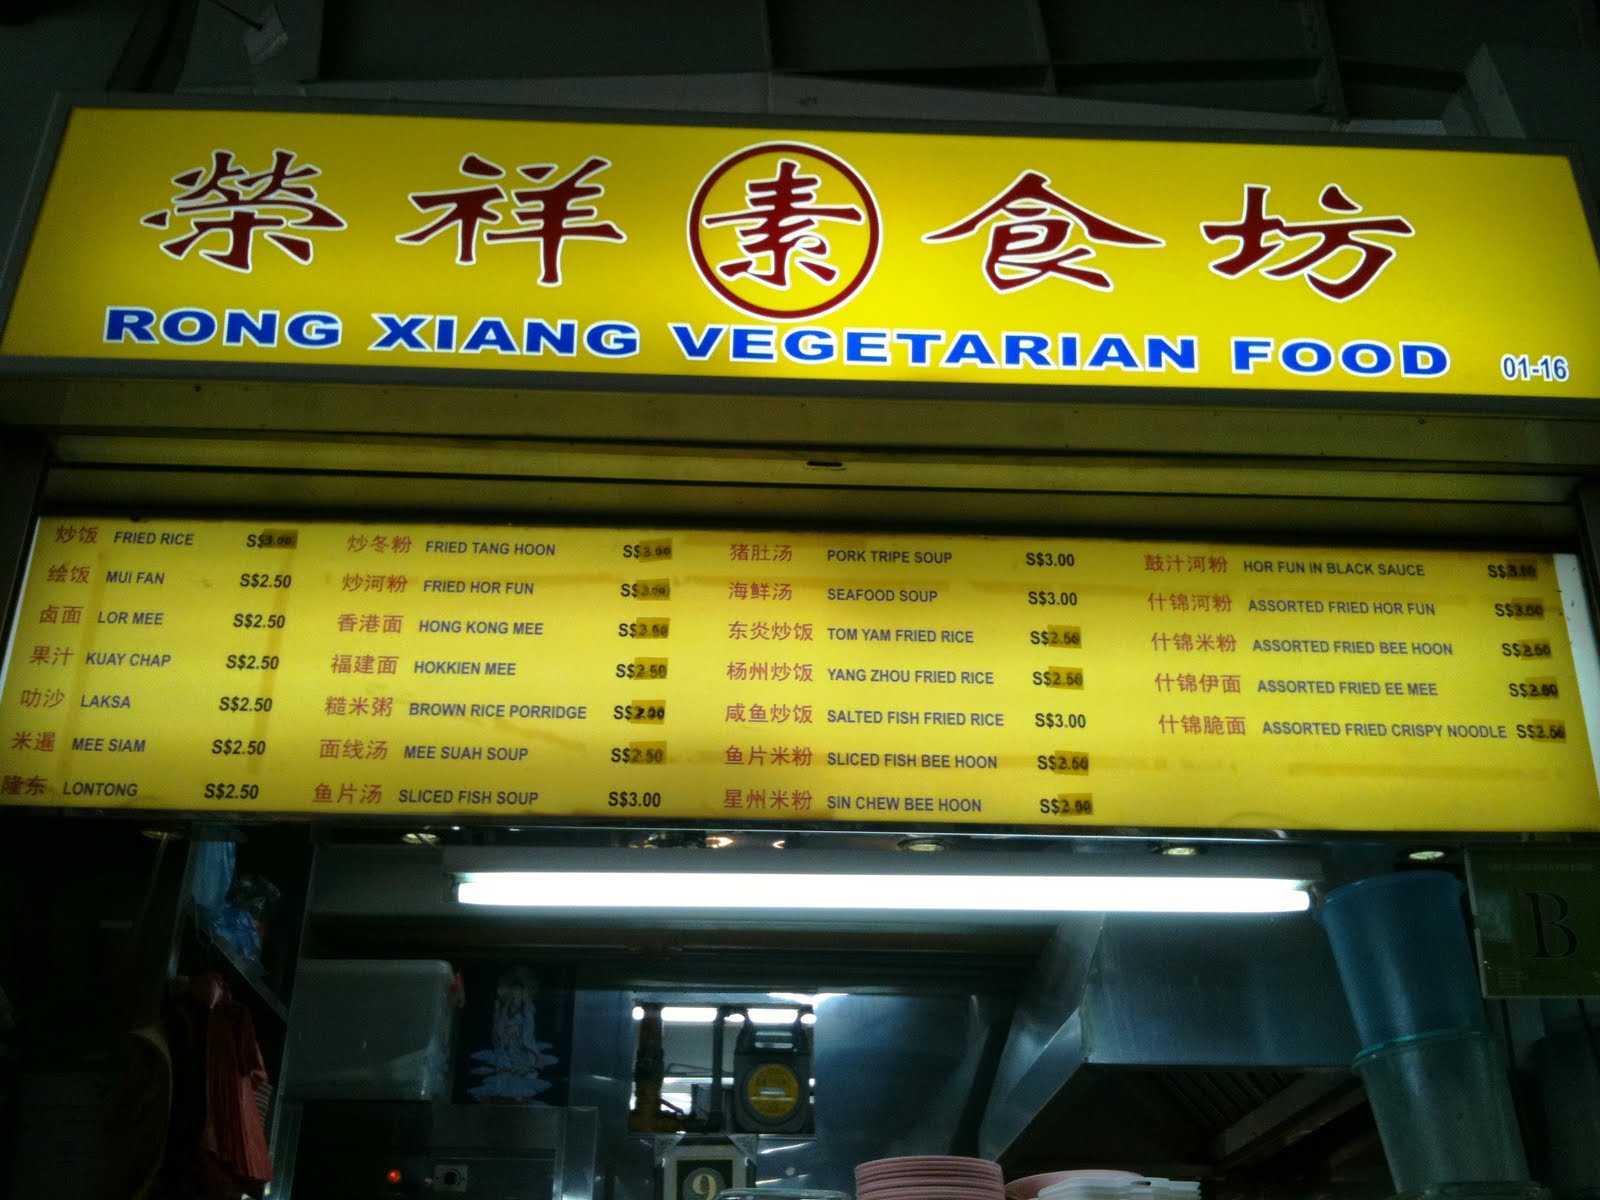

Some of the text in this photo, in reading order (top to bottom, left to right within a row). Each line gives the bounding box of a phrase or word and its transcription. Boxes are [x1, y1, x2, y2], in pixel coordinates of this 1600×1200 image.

[104, 305, 1452, 380] RONG XIANG VEGETARIAN FOOD
[1499, 353, 1570, 383] 01-16
[54, 526, 99, 545] 炒饭
[113, 530, 195, 546] FRIED RICE
[347, 534, 413, 555] 炒冬粉
[425, 540, 556, 556] FRIED TANG HOON
[730, 543, 793, 563] 猪肚汤
[827, 548, 953, 564] PORK TRIPE SOUP
[1025, 552, 1076, 568] S$3.00
[1243, 560, 1426, 576] HOR FUN IN BLACK SAUCE
[105, 570, 165, 585] MUI FAN
[240, 573, 293, 589] S$2.50
[341, 573, 408, 593] 炒河粉
[423, 579, 535, 595] FRIED HOR FUN
[728, 582, 793, 601] 海鲜汤
[827, 587, 939, 603] SEAFOOD SOUP
[1027, 591, 1078, 607] S$3.00
[1147, 592, 1232, 612] 什锦河粉
[1248, 599, 1436, 616] ASSORTED FRIED HOR FUN
[38, 605, 83, 626] 卤面
[96, 610, 164, 626] LOR MEE
[232, 613, 286, 630] S$2.50
[336, 613, 404, 635] 香港面
[418, 619, 544, 636] HONG KONG MEE
[727, 621, 814, 642] 东炎炒饭
[826, 627, 975, 644] TOM YAM FRIED RICE
[1151, 632, 1237, 653] 什锦米粉
[1252, 639, 1454, 656] ASSORTED FRIED BEE HOON
[29, 647, 75, 666] 果汁
[85, 651, 172, 667] KUAY CHAP
[226, 654, 280, 671] S$2.50
[330, 654, 399, 675] 福建面
[413, 660, 517, 676] HOKKIEN MEE
[827, 668, 995, 685] YANG ZHOU FRIED RICE
[1154, 673, 1242, 694] 什锦伊面
[1257, 679, 1439, 697] ASSORTED FRIED EE MEE
[20, 688, 66, 709] 叻沙
[79, 694, 131, 709] LAKSA
[218, 696, 274, 713] S$2.50
[408, 702, 587, 720] BROWN RICE PORRIDGE
[725, 703, 814, 725] 咸鱼炒饭
[827, 709, 1005, 727] SALTED FISH FRIED RICE
[1034, 713, 1086, 730] S$3.00
[1158, 714, 1247, 736] 什锦脆面
[1262, 721, 1508, 739] ASSORTED FRIED CRISPY NOODLE
[70, 737, 146, 753] MEE SIAM
[211, 739, 266, 757] S$2.50
[319, 738, 389, 760] 面线汤
[403, 745, 529, 762] MEE SUAH SOUP
[724, 745, 814, 767] 鱼片米粉
[826, 751, 998, 769] SLICED FISH BEE HOON
[62, 781, 138, 798] LONTONG
[203, 783, 260, 801] S$2.50
[312, 782, 383, 805] 鱼片汤
[398, 789, 539, 806] SLICED FISH SOUP
[607, 791, 662, 809] S$3.00
[724, 789, 813, 811] 星州米粉
[827, 795, 982, 813] SIN CHEW BEE HOON
[1523, 891, 1579, 959] B
[692, 1174, 718, 1200] 9
